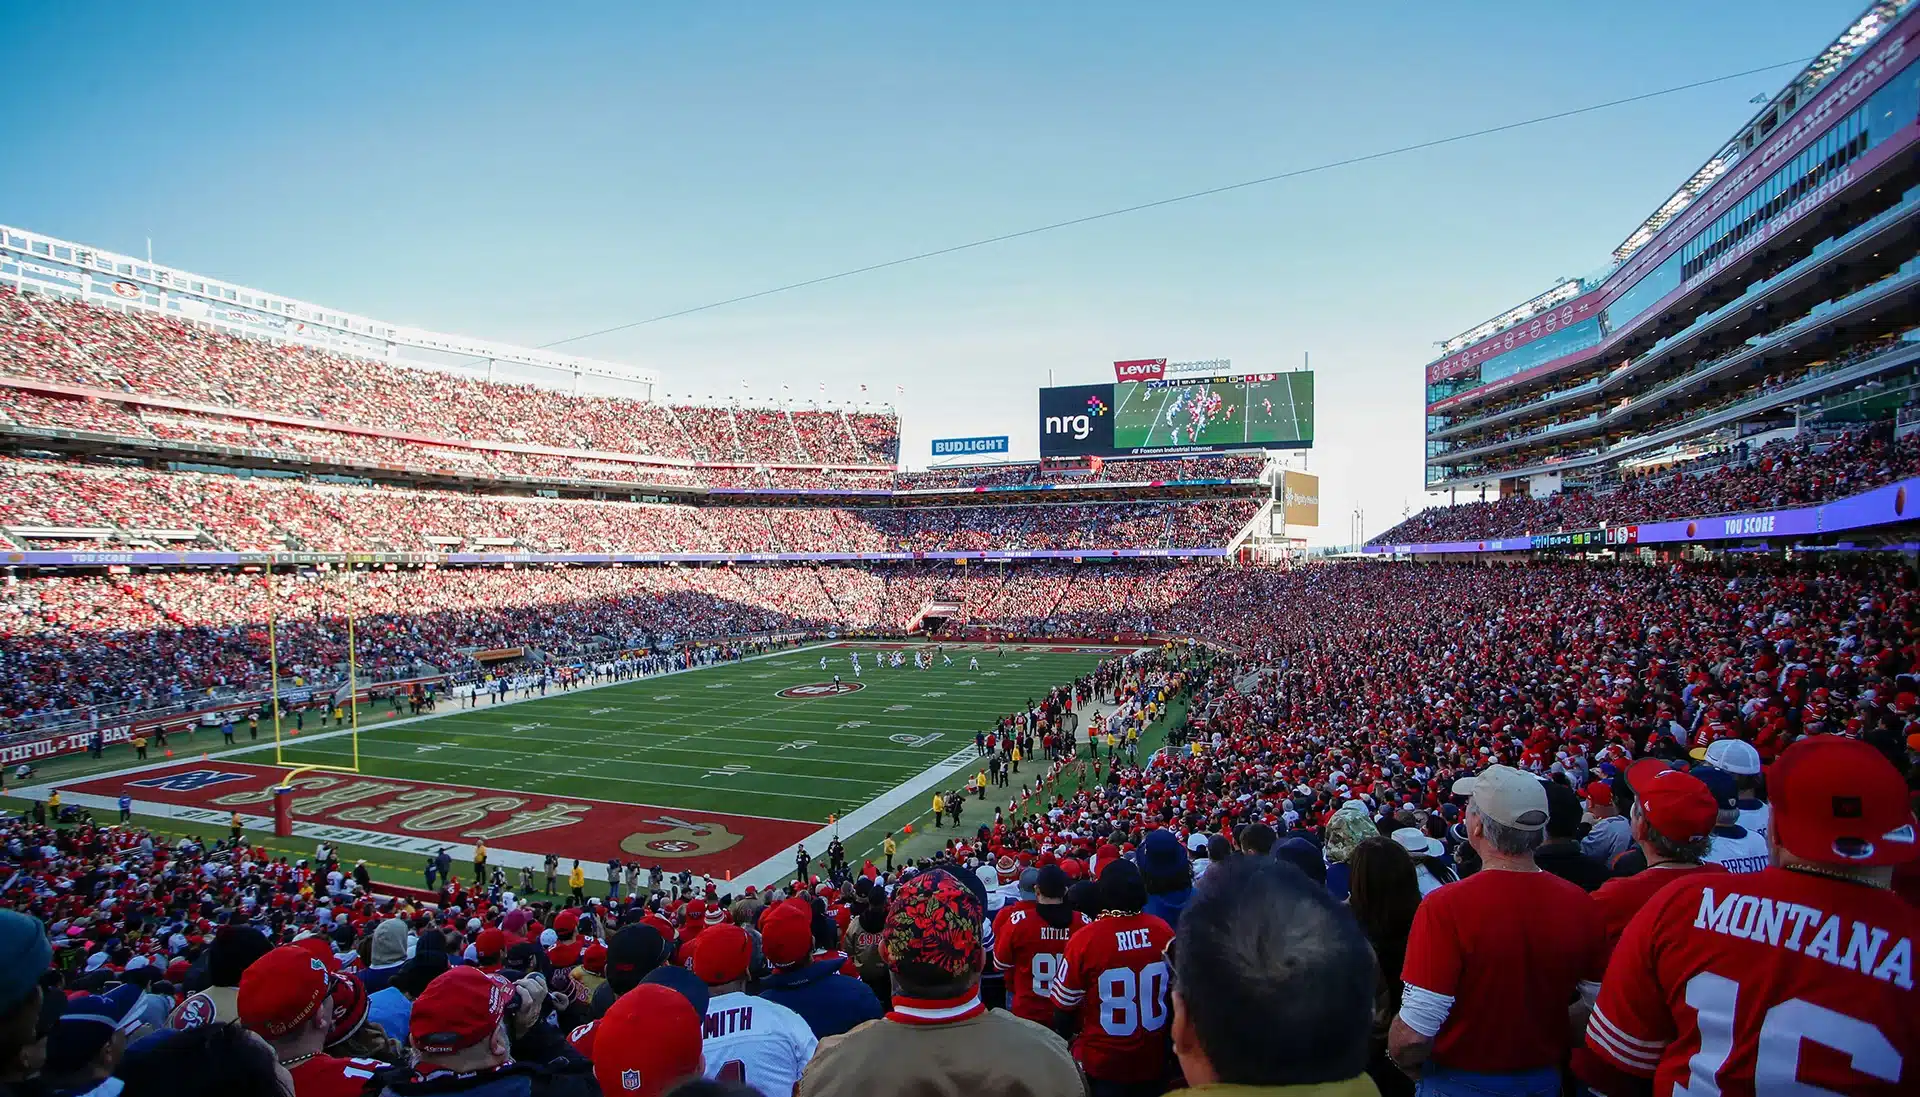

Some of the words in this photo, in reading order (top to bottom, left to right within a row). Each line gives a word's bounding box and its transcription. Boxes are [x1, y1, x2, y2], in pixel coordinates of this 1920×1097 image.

[1685, 262, 1717, 293] HOME
[1719, 249, 1737, 269] OF
[1737, 226, 1766, 256] THE
[1769, 168, 1855, 235] FAITHFUL
[1725, 518, 1742, 535] YOU
[1743, 515, 1775, 534] SCORE
[72, 553, 95, 563] YOU
[97, 553, 133, 563] SCORE
[102, 725, 132, 743] BAY
[170, 809, 217, 821] US
[314, 828, 413, 848] TAKES
[1040, 927, 1070, 941] KITTLE
[1115, 928, 1152, 952] RICE
[1693, 887, 1914, 991] MONTANA
[1098, 961, 1170, 1036] 80
[702, 1006, 753, 1040] MITH
[1671, 970, 1903, 1097] 16
